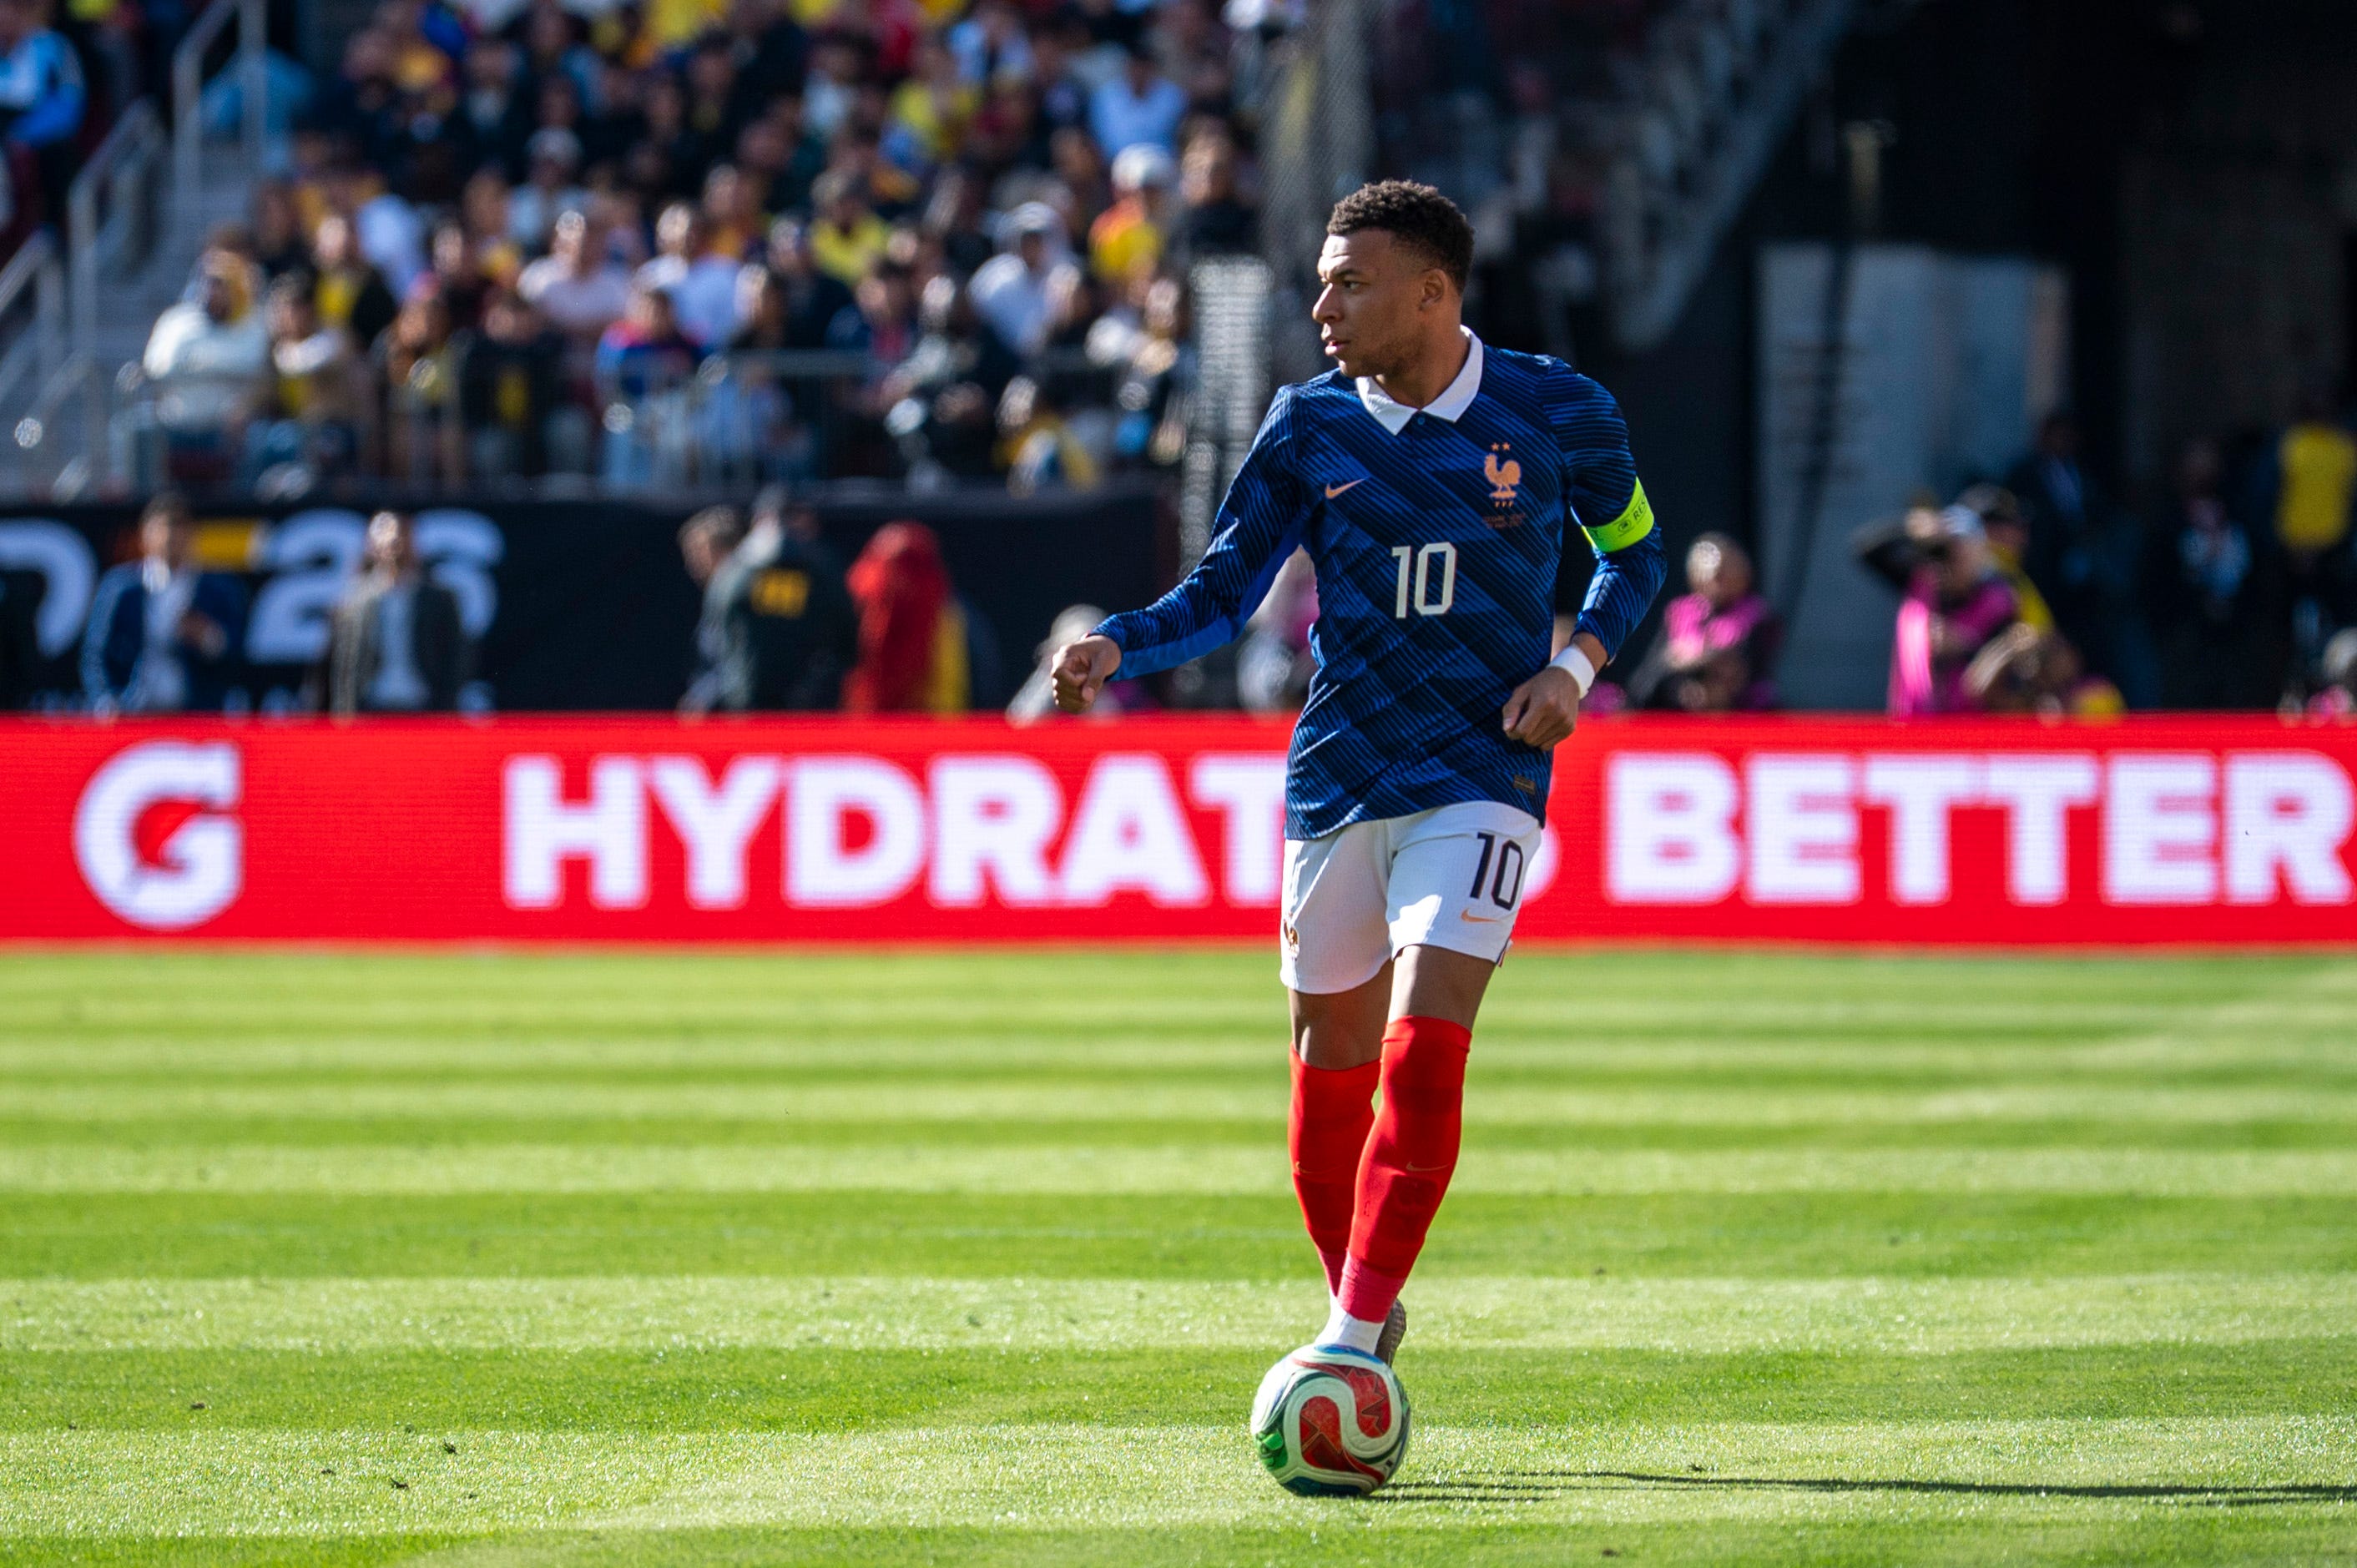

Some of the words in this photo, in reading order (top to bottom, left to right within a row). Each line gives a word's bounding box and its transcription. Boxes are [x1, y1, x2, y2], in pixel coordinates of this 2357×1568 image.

[1391, 542, 1457, 619] 10
[503, 754, 1560, 908] HYDRAT
[1604, 751, 2355, 905] BETTER
[1469, 832, 1524, 911] 10
